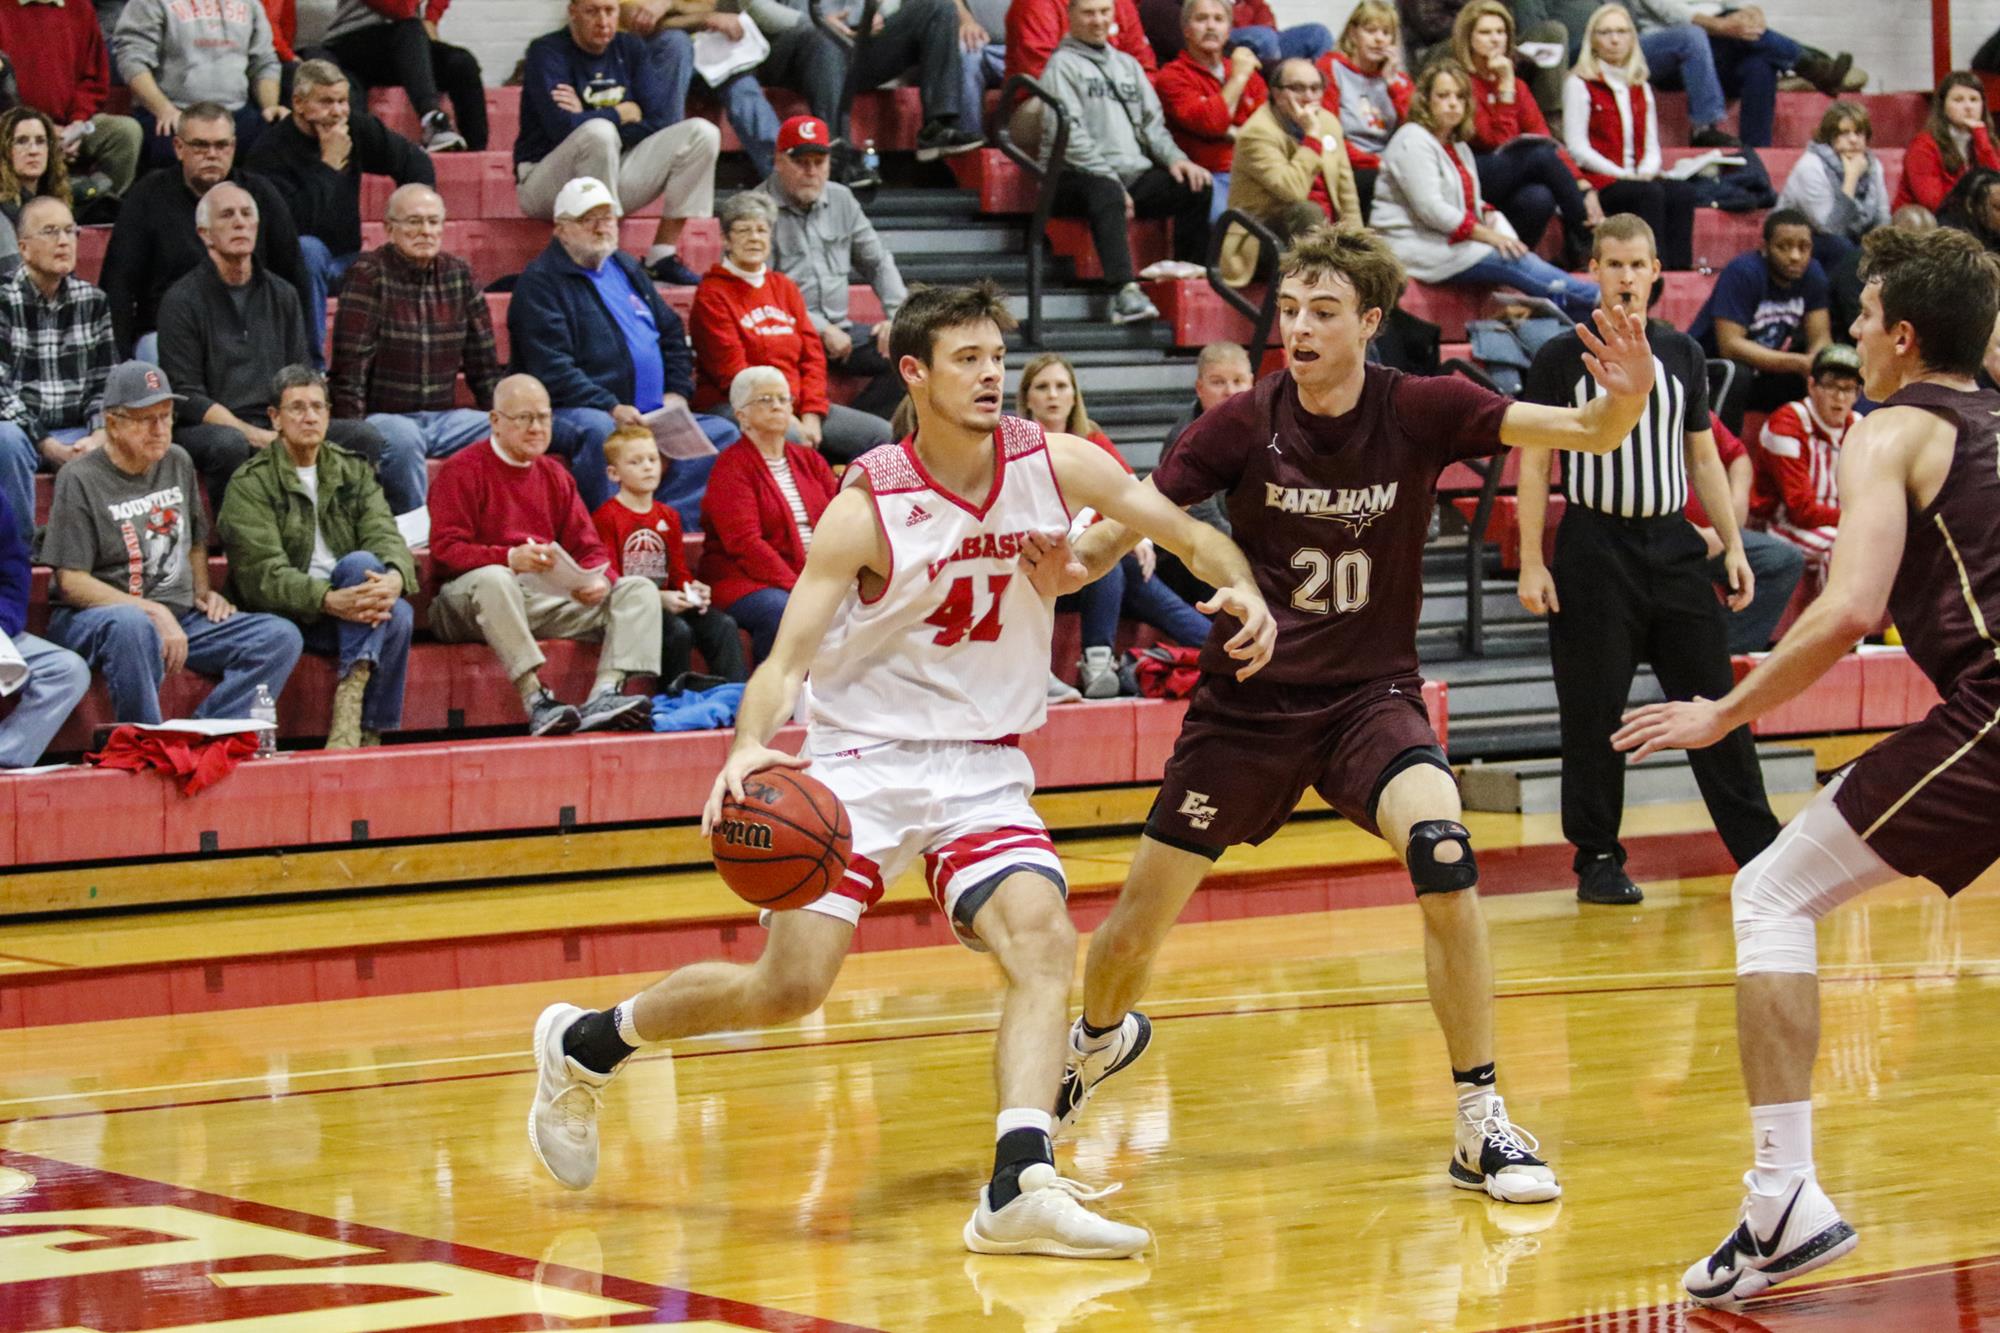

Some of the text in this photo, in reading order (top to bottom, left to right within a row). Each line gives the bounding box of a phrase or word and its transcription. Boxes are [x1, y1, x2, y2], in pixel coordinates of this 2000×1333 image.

[1264, 481, 1398, 514] EARLHAM
[905, 513, 933, 527] adidas
[1290, 547, 1372, 615] 20
